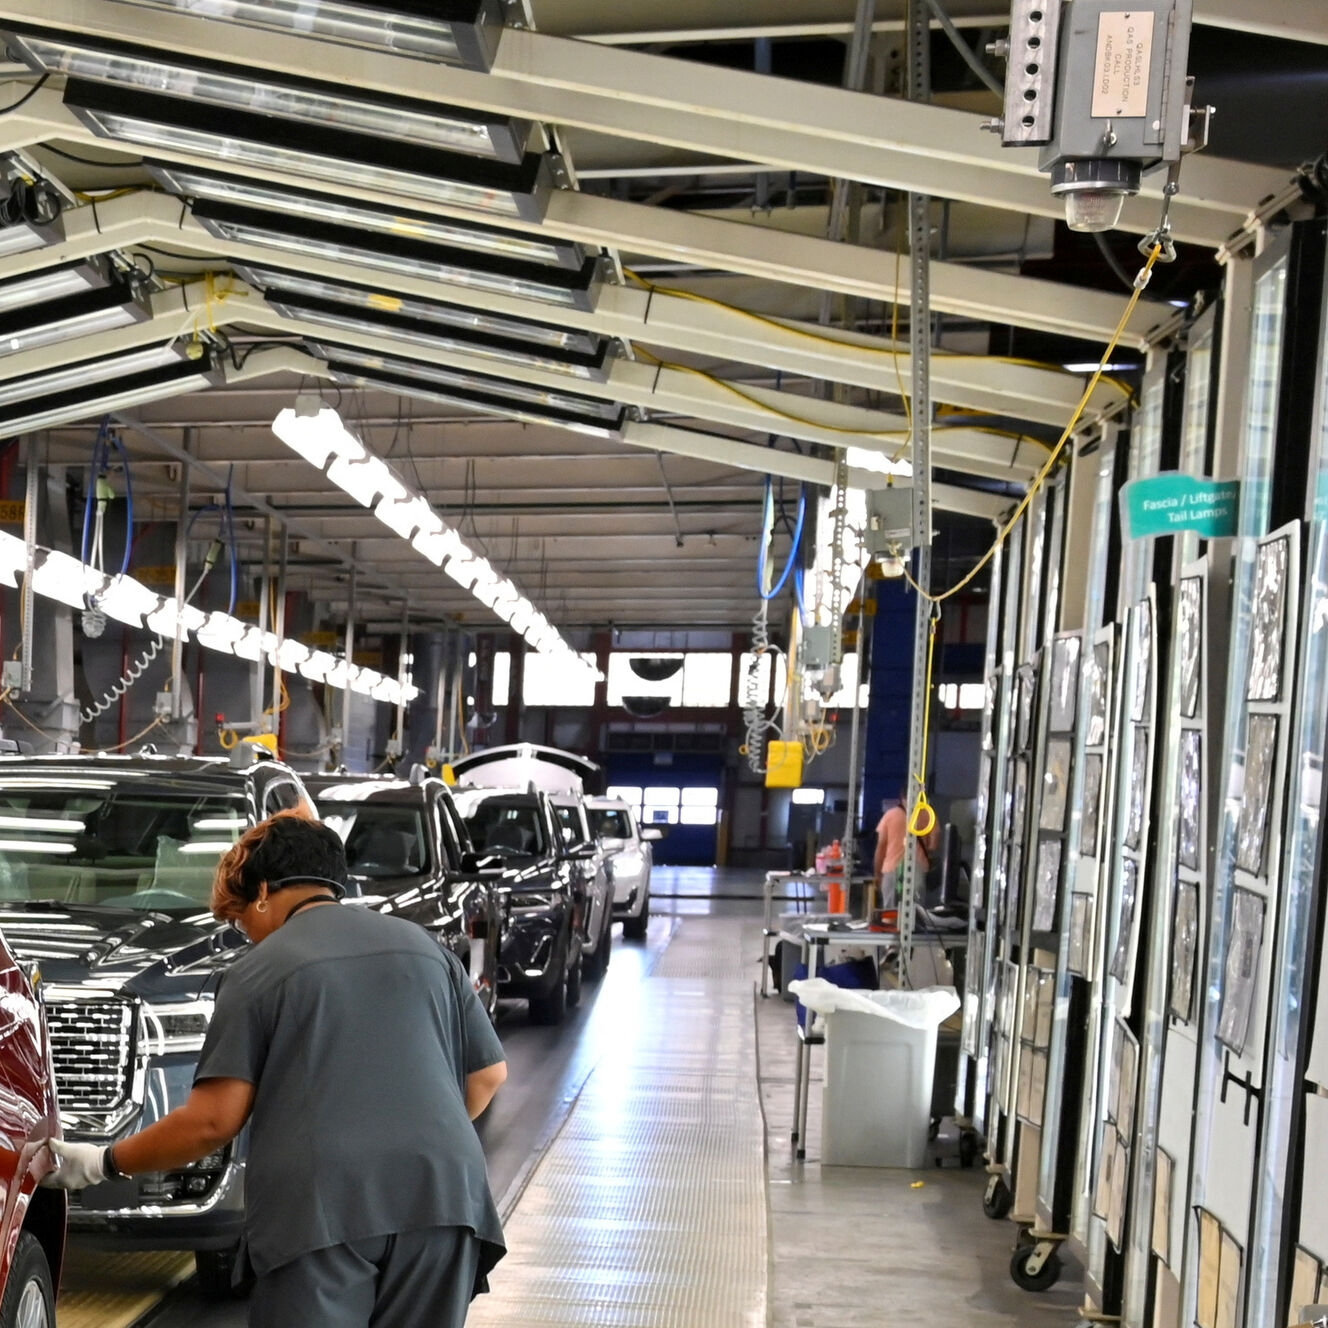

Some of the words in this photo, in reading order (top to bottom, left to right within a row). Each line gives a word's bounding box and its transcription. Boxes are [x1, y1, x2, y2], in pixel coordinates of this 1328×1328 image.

[1126, 26, 1135, 45] QAS
[1113, 54, 1122, 74] CALL
[1122, 48, 1133, 102] PRODUCTION
[1143, 497, 1178, 511] Fascia
[1180, 494, 1187, 507] /
[1168, 509, 1188, 522] Tail
[1190, 507, 1227, 520] Lamps
